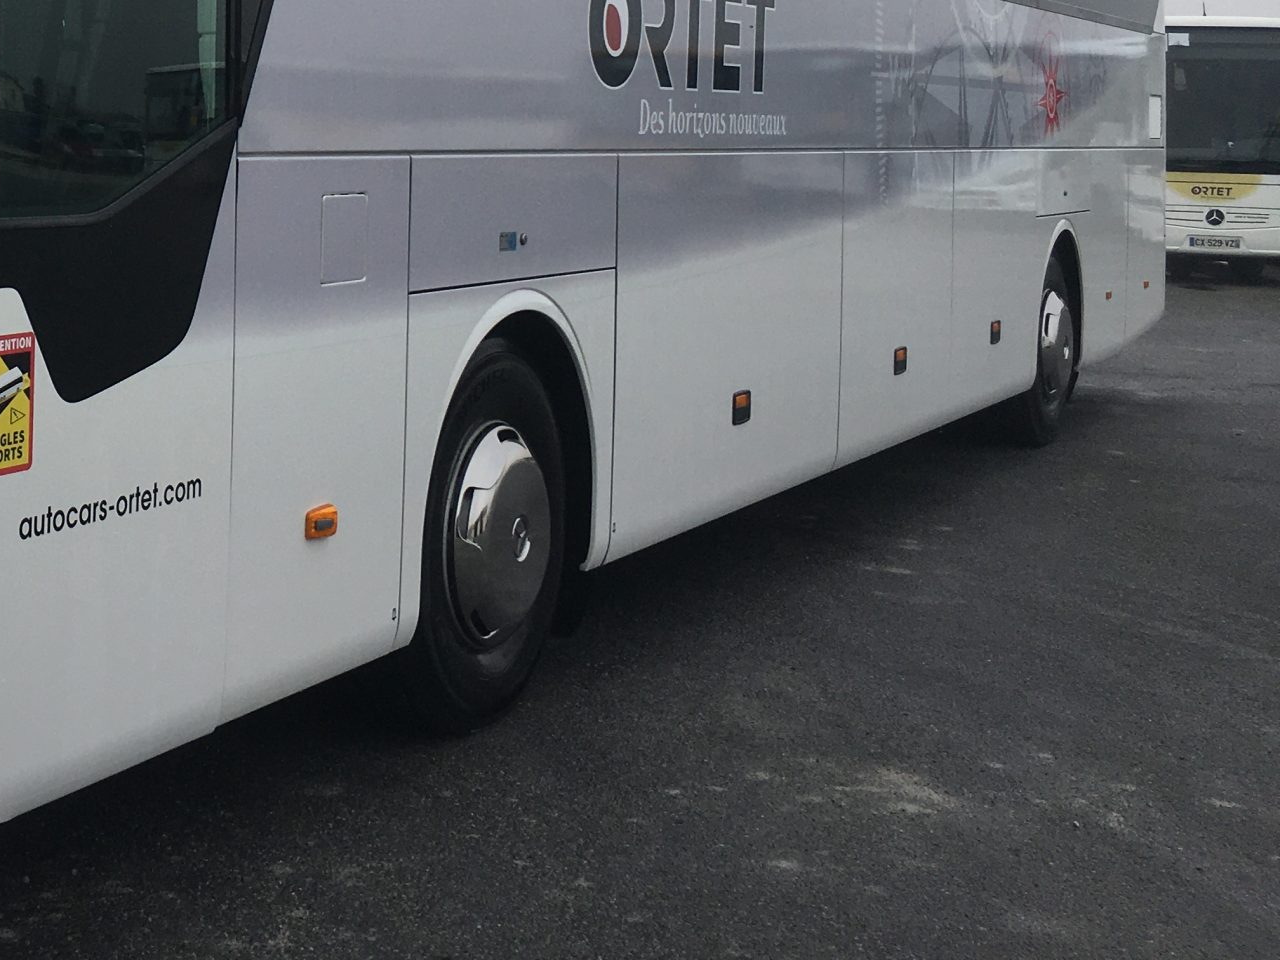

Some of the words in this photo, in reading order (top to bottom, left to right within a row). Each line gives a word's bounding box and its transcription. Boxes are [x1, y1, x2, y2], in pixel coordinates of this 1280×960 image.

[638, 98, 665, 135] Des
[667, 98, 726, 138] horizons
[729, 113, 787, 136] nouveaux
[1191, 186, 1233, 196] ORTET
[19, 477, 202, 540] autocars-ortet.com
